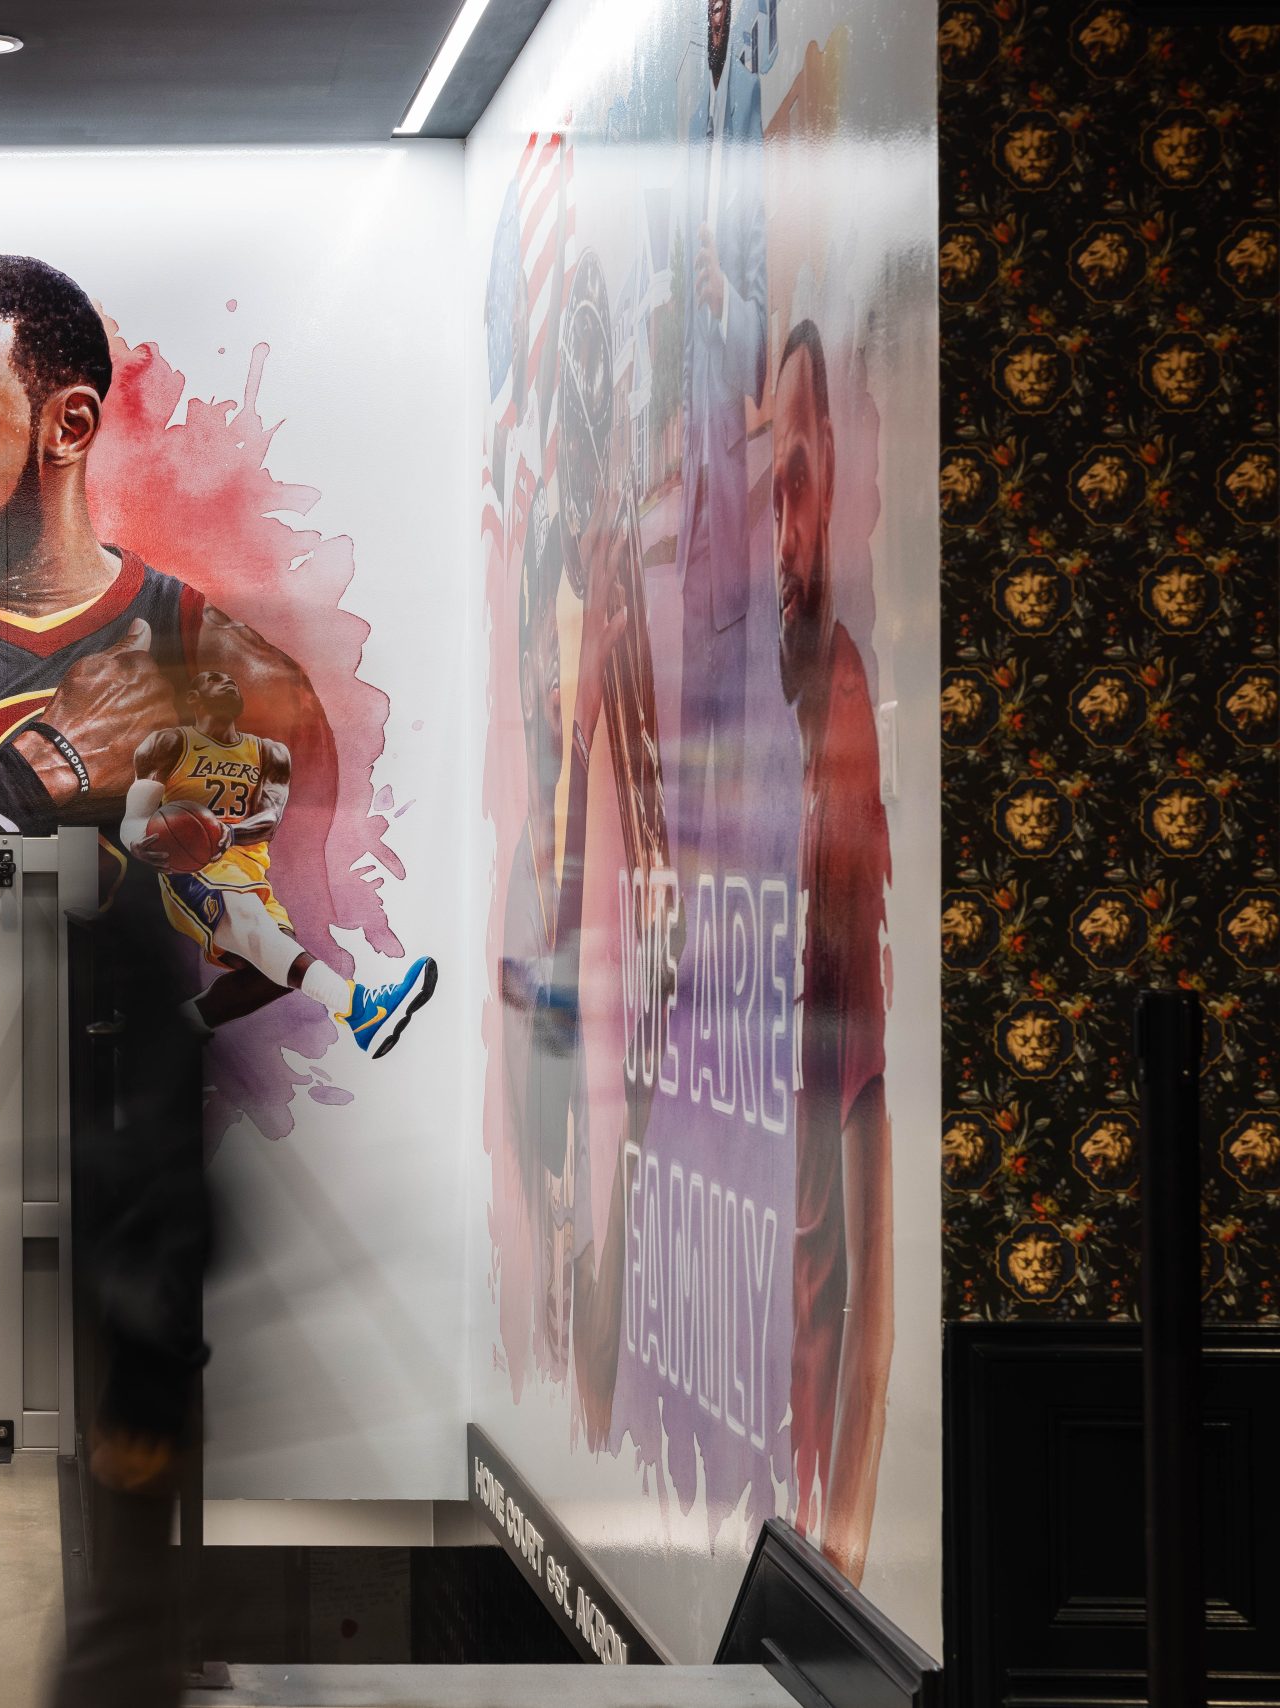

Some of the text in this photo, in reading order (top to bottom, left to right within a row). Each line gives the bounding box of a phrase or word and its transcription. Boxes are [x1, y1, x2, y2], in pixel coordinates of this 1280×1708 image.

[53, 735, 89, 792] I PROMISE
[187, 755, 261, 785] LAKERS
[205, 778, 250, 817] 23
[619, 867, 790, 1137] WE ARE
[622, 1140, 779, 1452] FAMILY
[474, 1456, 506, 1528] HOME
[506, 1496, 545, 1578] COURT
